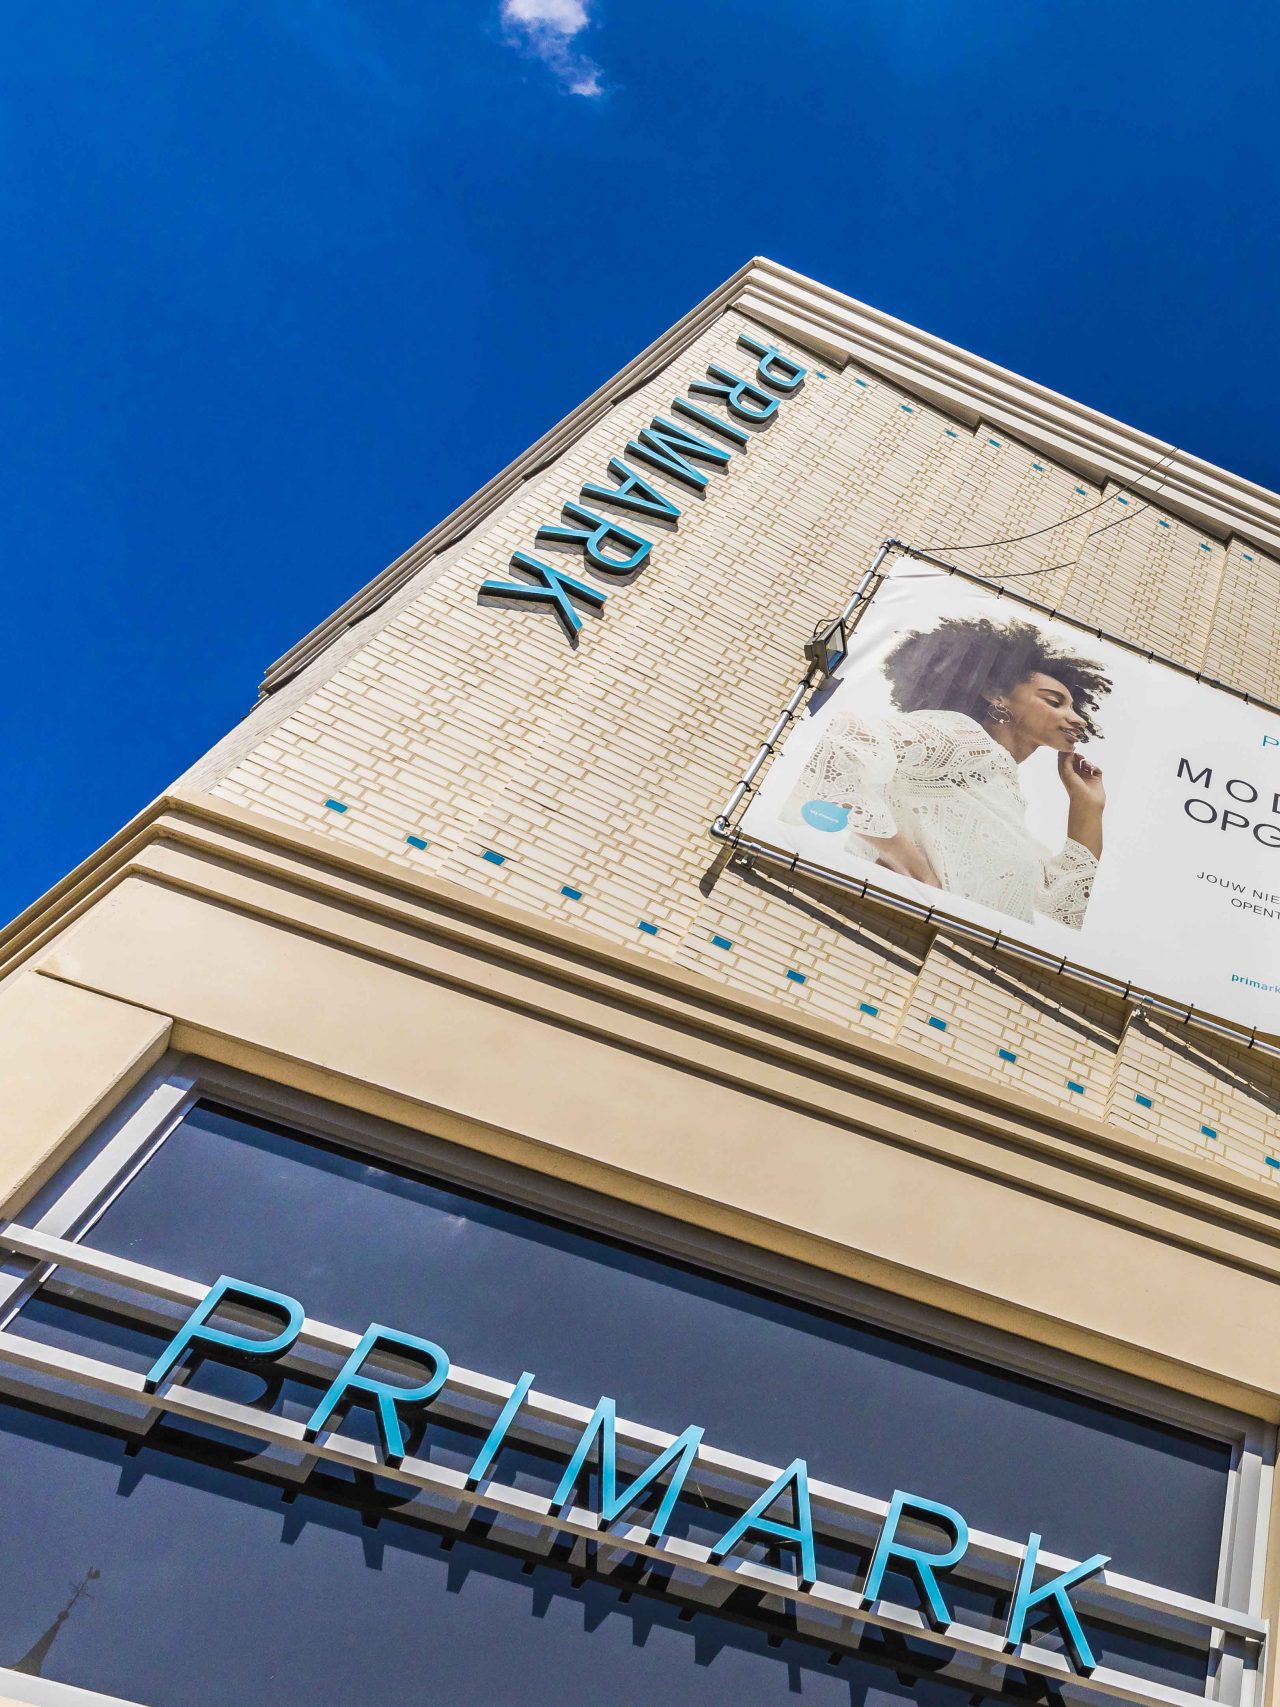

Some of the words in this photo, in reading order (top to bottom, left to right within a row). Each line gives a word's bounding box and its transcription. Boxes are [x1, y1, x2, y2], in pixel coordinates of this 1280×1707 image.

[477, 333, 806, 642] PRIMARK
[1196, 871, 1246, 894] JOUW
[145, 1275, 1113, 1678] PRIMARK
